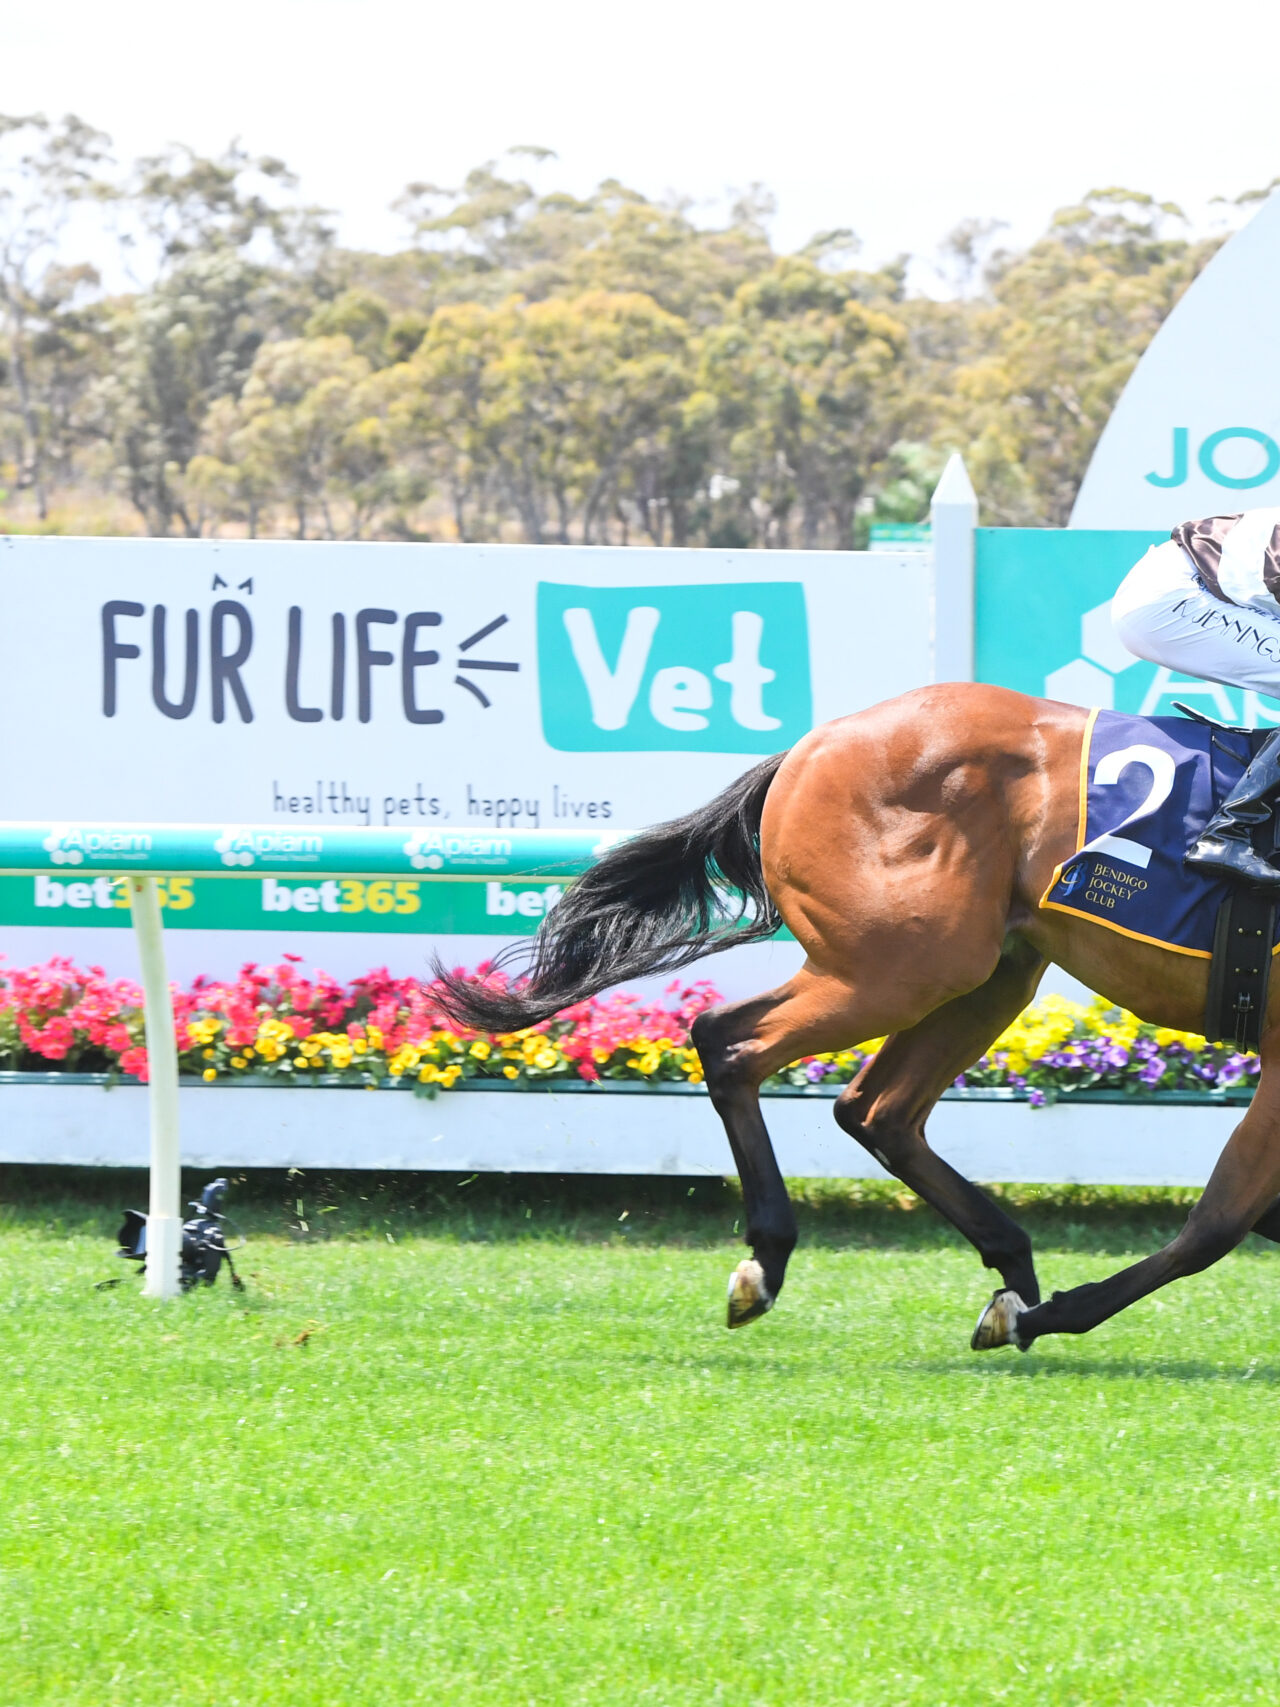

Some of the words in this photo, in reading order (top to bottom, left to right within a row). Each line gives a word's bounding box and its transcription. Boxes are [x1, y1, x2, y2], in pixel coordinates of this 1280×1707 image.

[101, 599, 254, 724] FUR
[285, 606, 445, 725] LIFE
[562, 606, 784, 732] Vet
[273, 780, 371, 827] healthy
[383, 783, 450, 827] pets,
[466, 784, 540, 829] happy
[553, 785, 613, 818] lives
[1079, 743, 1176, 869] 2
[64, 829, 152, 854] Apiam
[234, 830, 323, 856] Apiam
[422, 832, 512, 858] Apiam
[1088, 876, 1138, 901] JOCKEY
[1092, 863, 1148, 891] BENDIGO
[34, 876, 196, 910] bet35
[262, 878, 421, 914] bet365
[1084, 890, 1116, 909] CLUB
